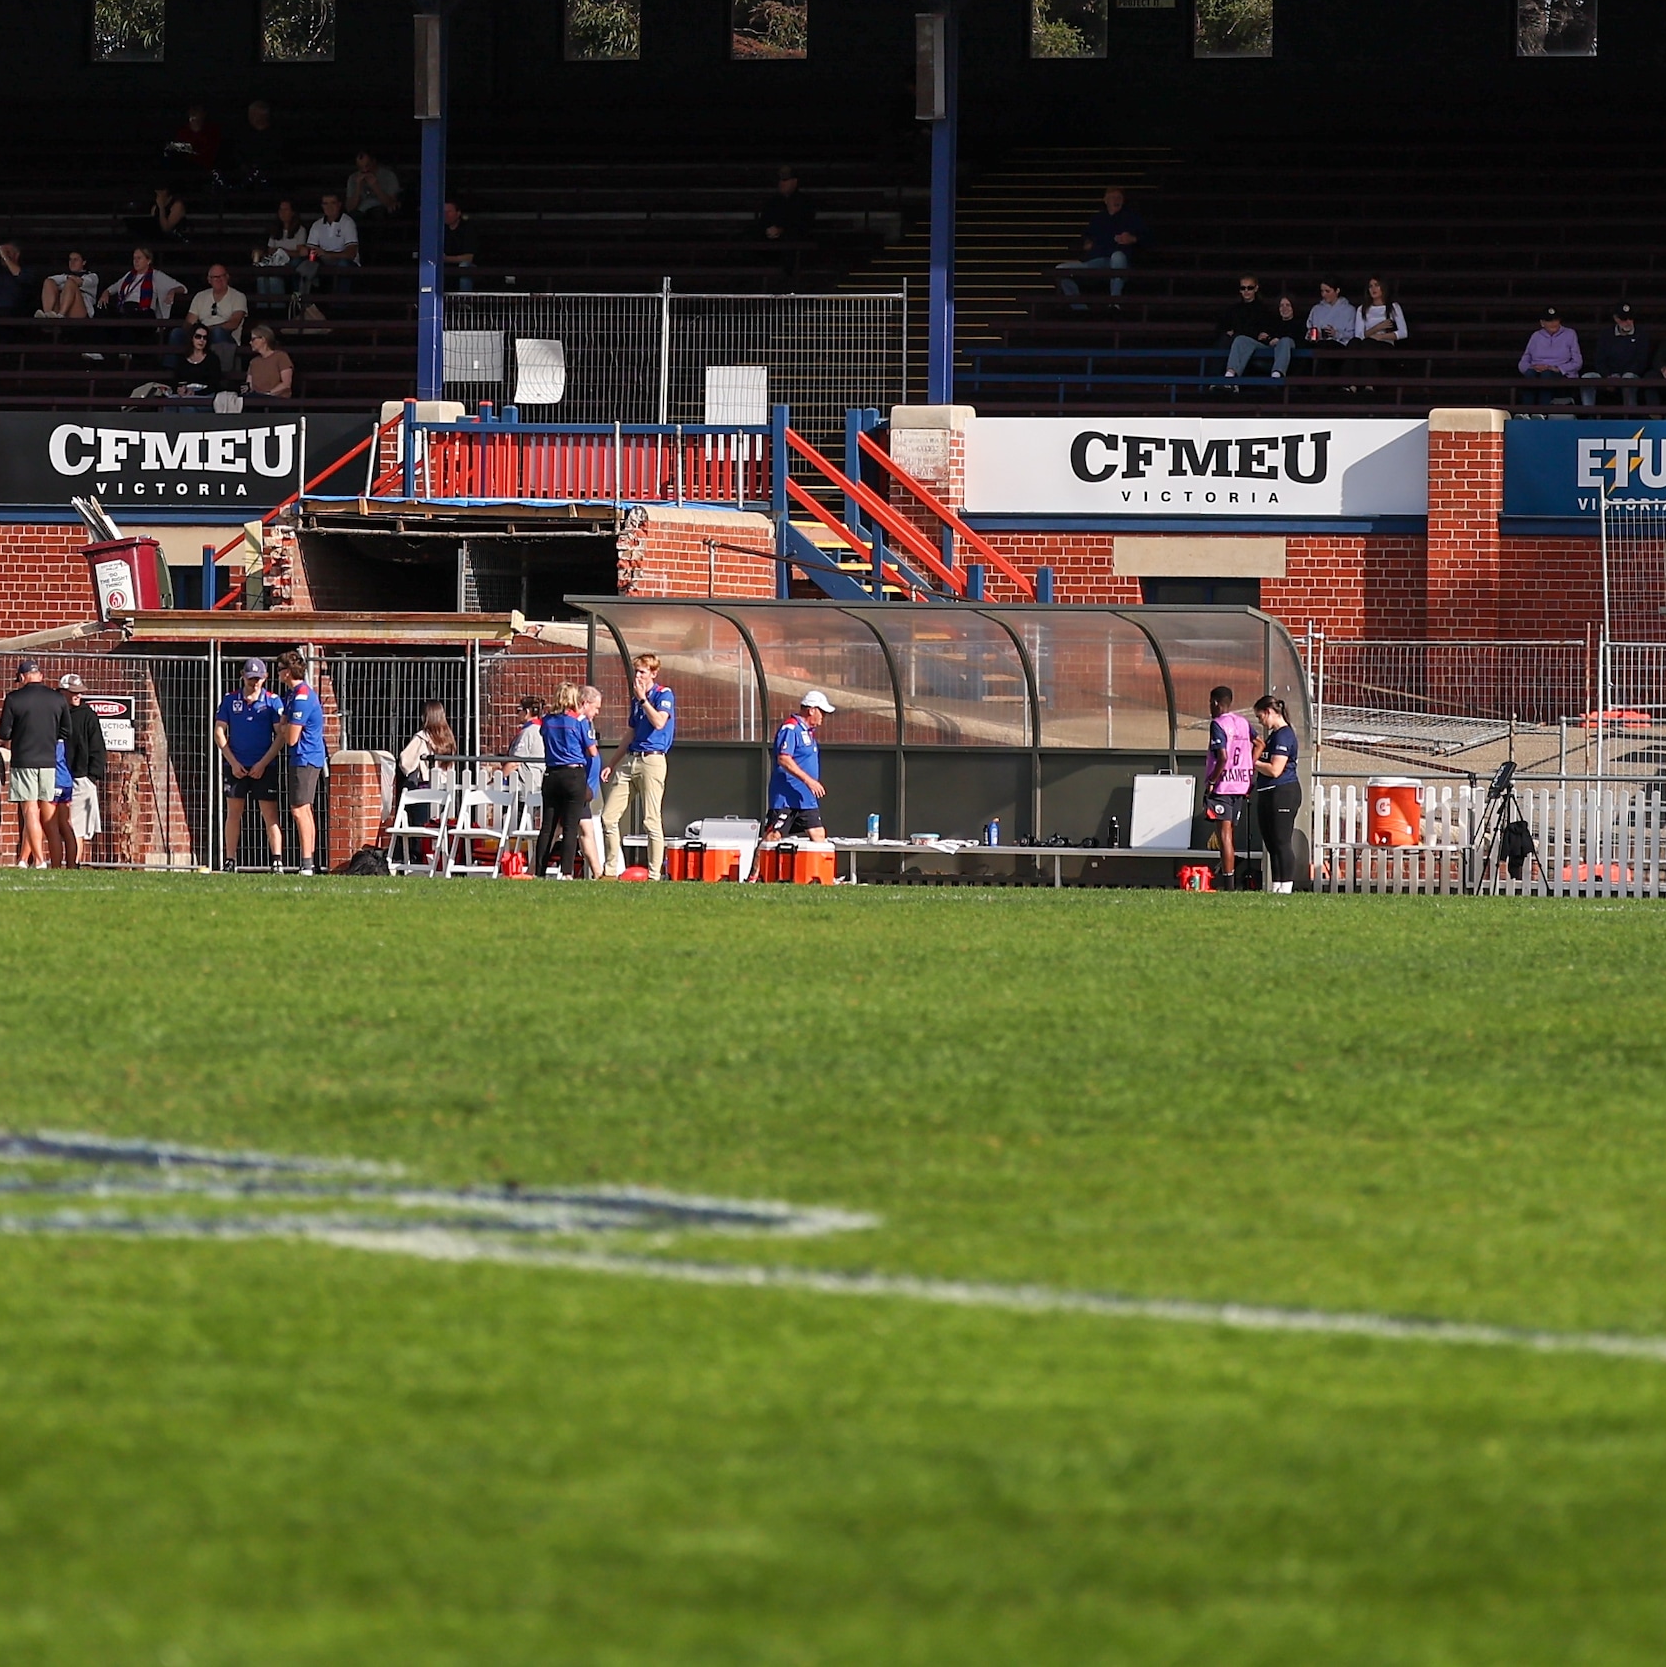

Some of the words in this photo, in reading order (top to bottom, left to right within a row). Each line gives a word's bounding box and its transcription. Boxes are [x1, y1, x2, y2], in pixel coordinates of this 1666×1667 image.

[48, 424, 296, 477] CFMEU
[1070, 430, 1331, 484] CFMEU
[96, 482, 248, 496] VICTORIA
[1121, 490, 1279, 503] VICTORIA
[90, 704, 120, 713] ANGER
